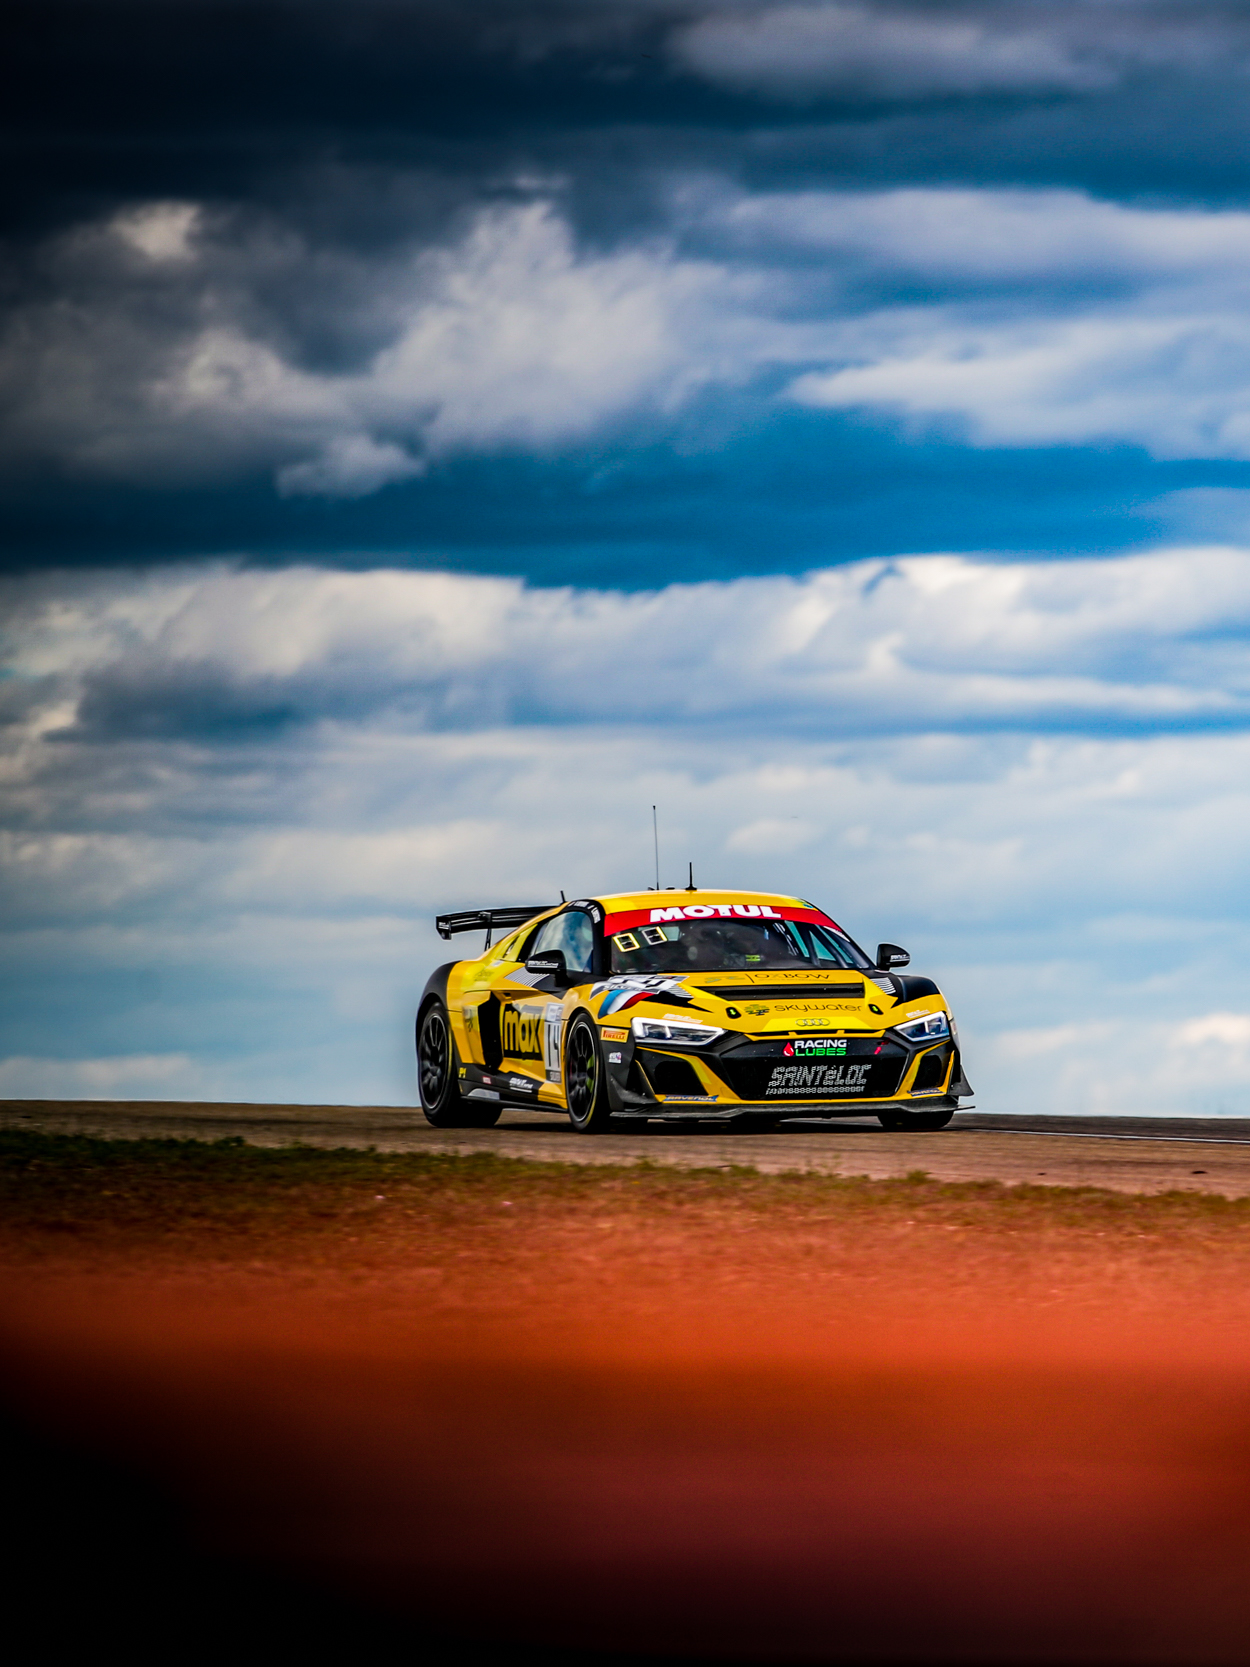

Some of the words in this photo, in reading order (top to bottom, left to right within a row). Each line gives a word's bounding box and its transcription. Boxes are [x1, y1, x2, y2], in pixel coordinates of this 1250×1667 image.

[650, 904, 781, 923] MOTUL
[774, 1003, 863, 1014] skywater
[504, 1010, 542, 1054] max
[547, 1024, 561, 1069] 14
[794, 1039, 848, 1049] RACING
[795, 1048, 847, 1057] LUBES
